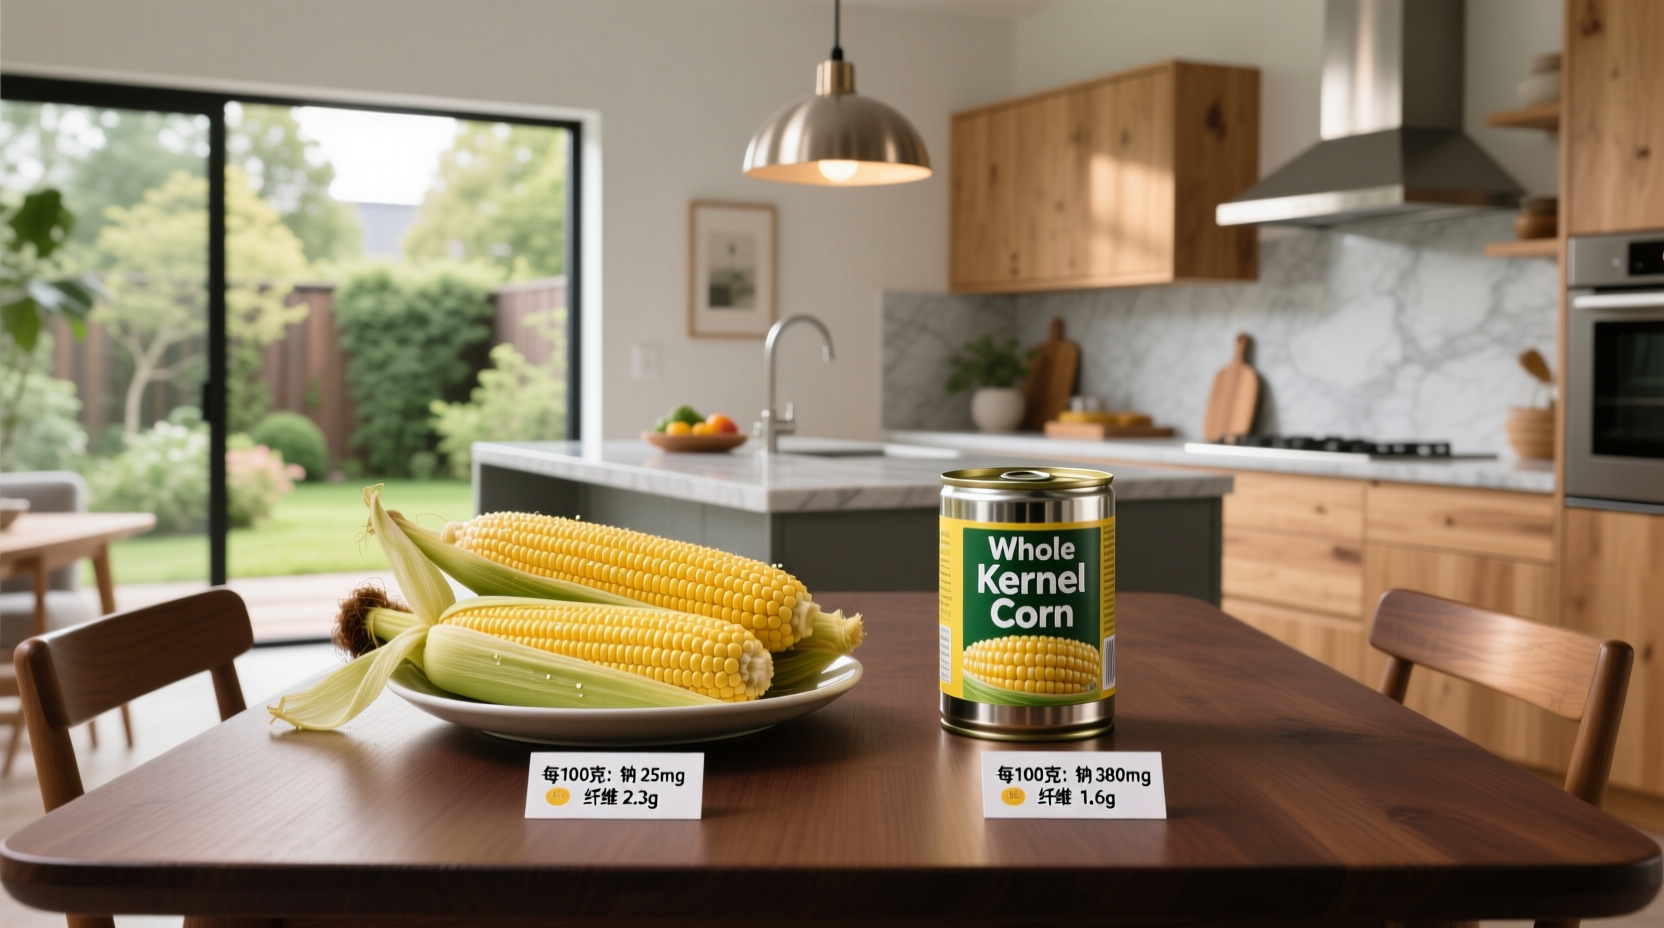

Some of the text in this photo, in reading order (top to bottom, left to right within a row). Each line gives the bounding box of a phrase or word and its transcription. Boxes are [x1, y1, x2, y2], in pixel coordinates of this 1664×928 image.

[988, 535, 1075, 561] Whole
[978, 562, 1085, 595] Kernel
[990, 598, 1074, 629] Corn
[641, 767, 685, 787] 25mg
[1096, 767, 1151, 787] 380mg
[622, 790, 659, 809] 2.3g
[1081, 790, 1116, 809] 1.6g
